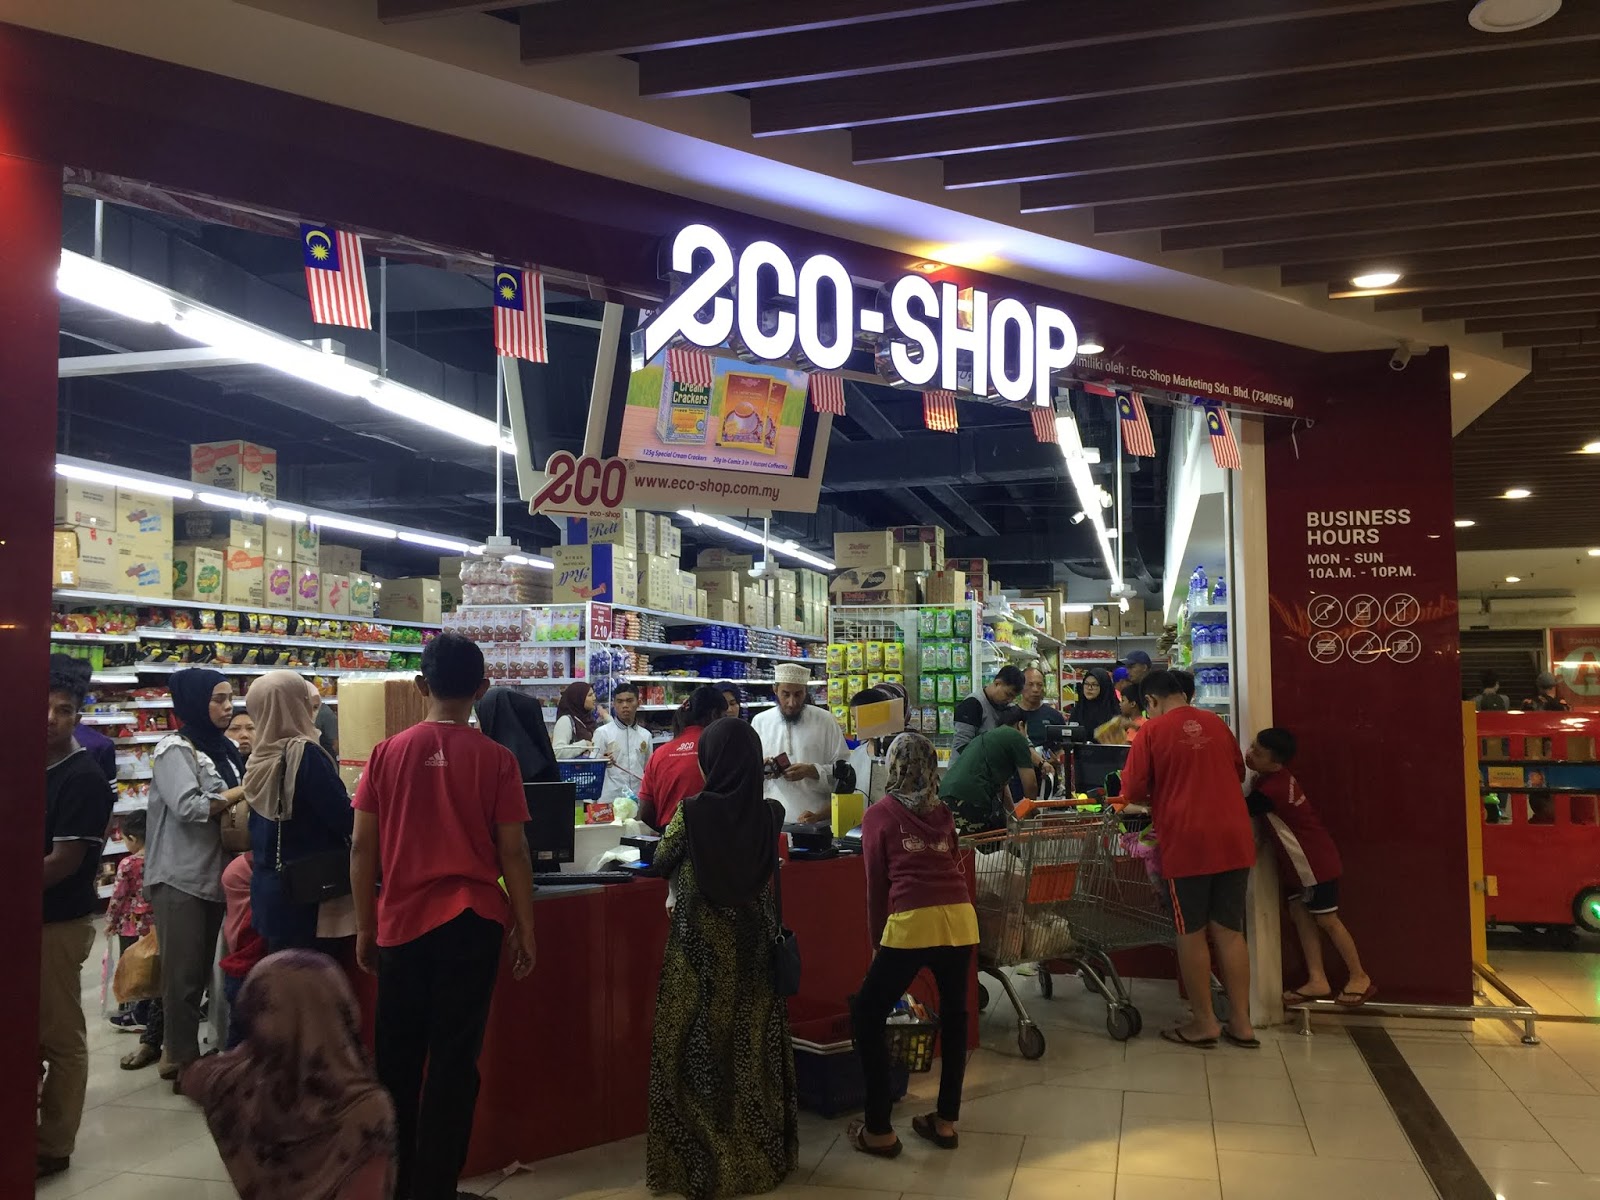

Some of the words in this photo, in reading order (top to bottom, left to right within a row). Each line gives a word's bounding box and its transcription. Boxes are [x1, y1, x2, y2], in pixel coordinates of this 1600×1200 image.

[1072, 354, 1103, 371] imiliki
[1105, 360, 1125, 375] oleh
[1131, 365, 1171, 384] Eco-Shop
[1173, 373, 1213, 394] Marketing
[1214, 381, 1231, 396] Sdn.
[1233, 385, 1250, 400] Bhd.
[1252, 388, 1294, 410] (734055-M)
[673, 392, 708, 405] Crackers
[655, 449, 672, 459] Special
[672, 451, 688, 460] Cream
[688, 453, 707, 461] Crackers
[634, 475, 780, 501] www.eco-shop.com.my
[1307, 508, 1411, 527] BUSINESS
[1307, 528, 1380, 545] HOURS
[1307, 553, 1340, 564] MON
[1354, 552, 1384, 563] SUN
[1308, 567, 1356, 579] 10A.M.
[1371, 565, 1416, 578] 10P.M.
[594, 624, 608, 638] 2.10
